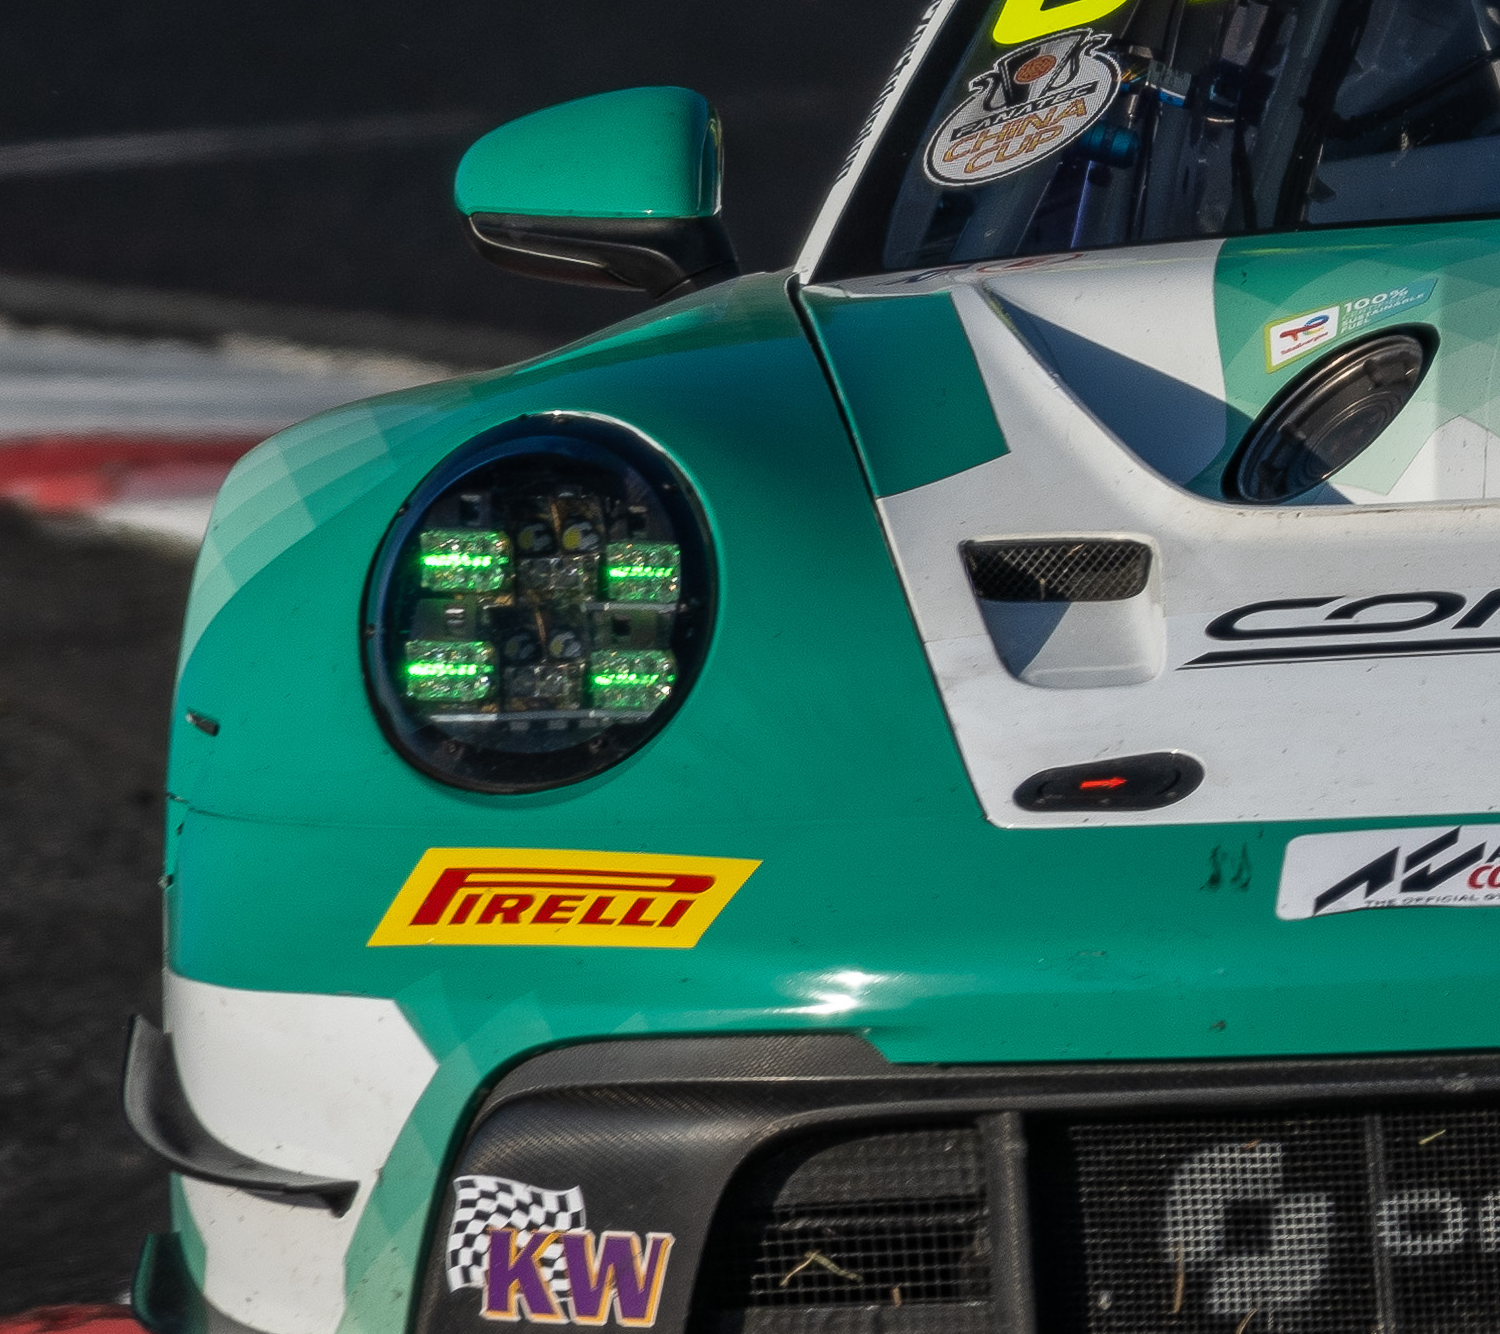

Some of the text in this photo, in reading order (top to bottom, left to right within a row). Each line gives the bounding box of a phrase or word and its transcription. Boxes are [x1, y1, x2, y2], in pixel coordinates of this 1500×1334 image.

[943, 98, 1087, 163] CHINA
[953, 82, 1097, 139] FANATEC
[964, 125, 1064, 174] CUP
[1344, 286, 1409, 313] 100%
[409, 867, 716, 928] PIRELLI
[479, 1227, 677, 1328] KW
